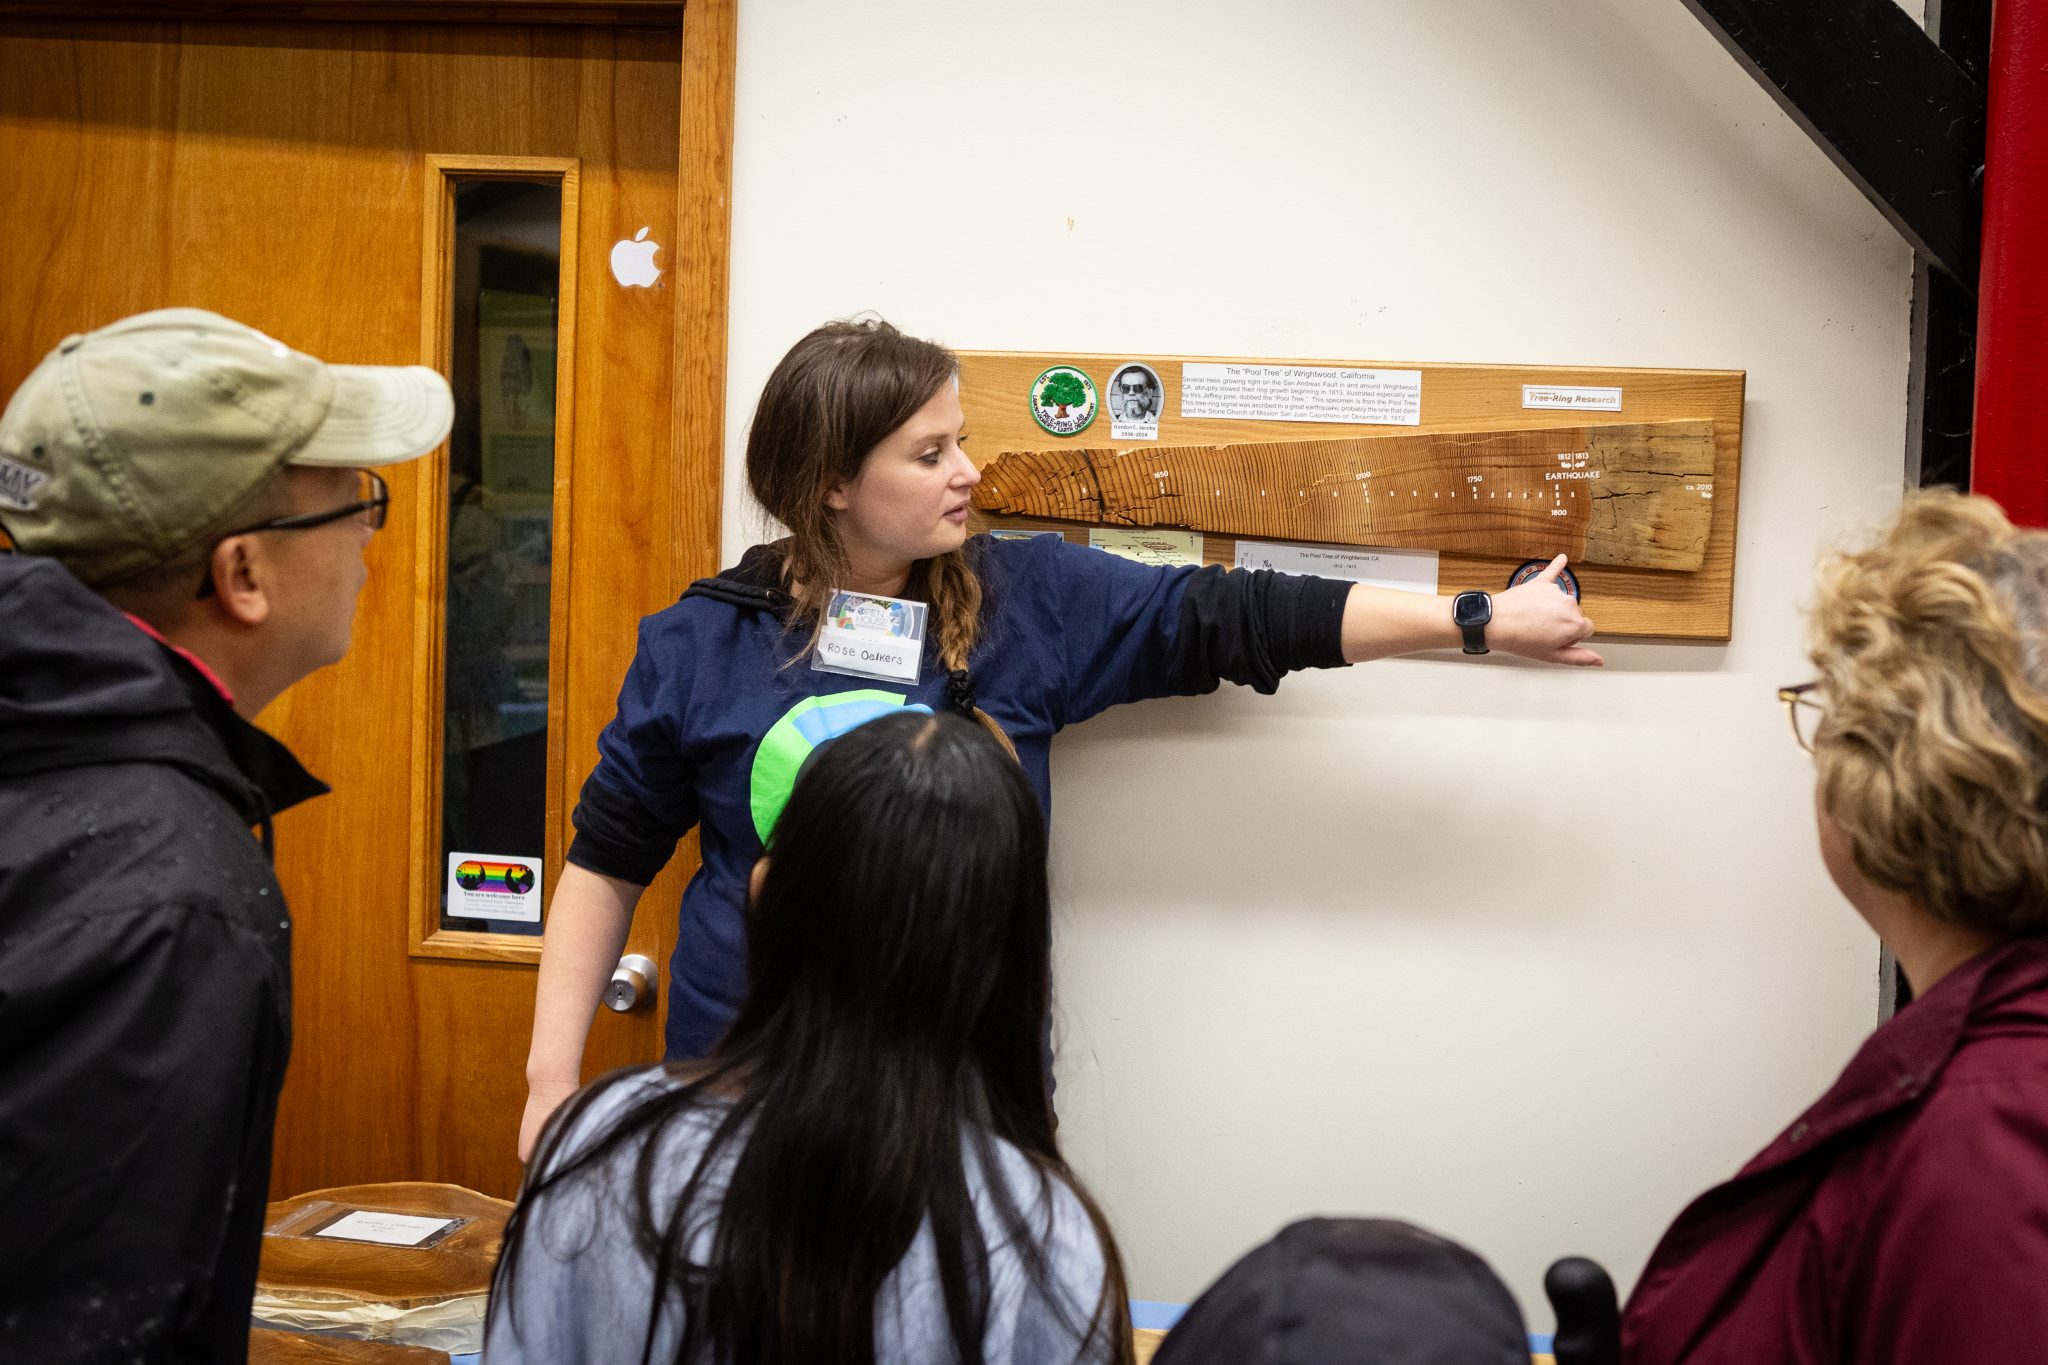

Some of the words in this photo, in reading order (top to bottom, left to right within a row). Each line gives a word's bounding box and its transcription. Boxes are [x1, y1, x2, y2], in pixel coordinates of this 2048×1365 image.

[1226, 367, 1240, 375] The
[1340, 371, 1375, 380] California
[1290, 388, 1319, 396] beginning
[1376, 391, 1405, 399] especially
[1529, 394, 1573, 403] Tree-Ring
[1575, 395, 1616, 403] Research
[1041, 409, 1073, 427] TREE-RING
[1072, 413, 1085, 424] LAB
[1575, 452, 1589, 460] 1813
[1153, 470, 1169, 479] 1650
[1355, 471, 1371, 480] 1700
[1466, 475, 1483, 483] 1750
[1545, 470, 1601, 480] EARTHQUAKE
[1696, 483, 1713, 491] 2010
[855, 615, 887, 626] HOUSE
[827, 643, 856, 657] Rose
[861, 650, 903, 665] Oelkers
